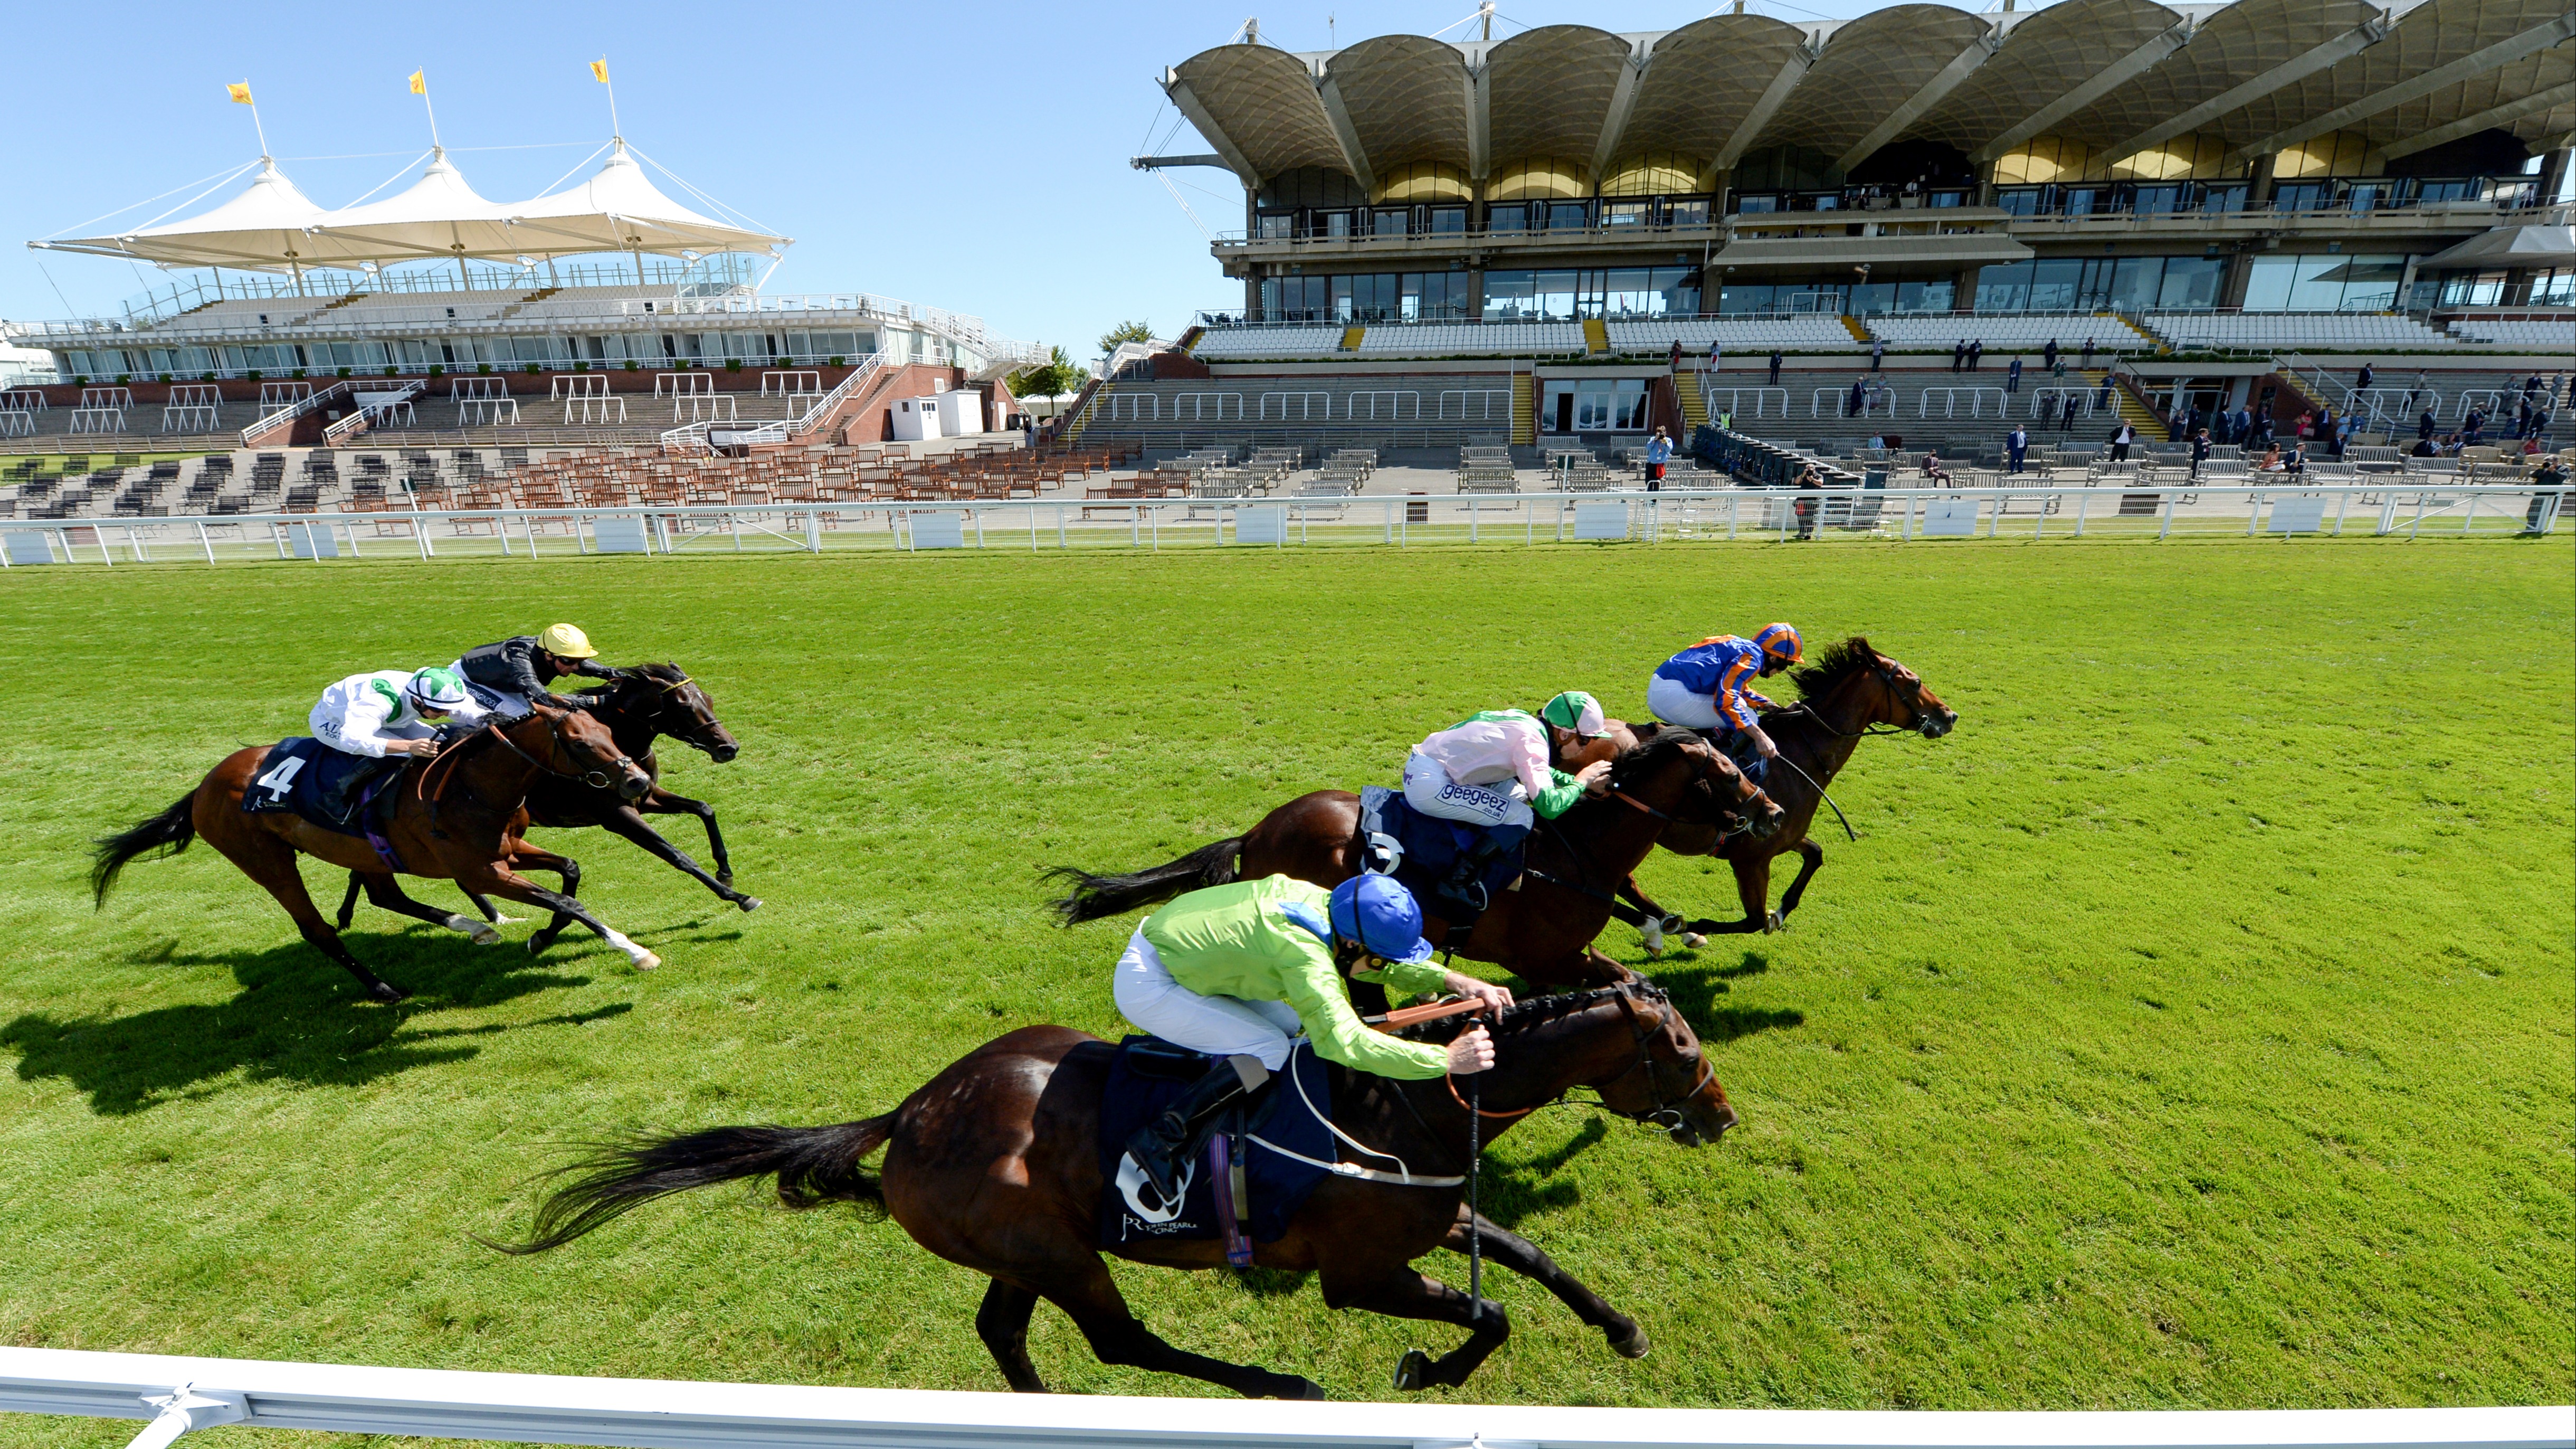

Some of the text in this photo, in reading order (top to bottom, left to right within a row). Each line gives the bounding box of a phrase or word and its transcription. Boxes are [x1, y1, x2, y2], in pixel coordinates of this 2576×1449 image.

[257, 756, 306, 802] 4
[1441, 784, 1507, 812] geegeez
[1482, 808, 1501, 818] .co.uk
